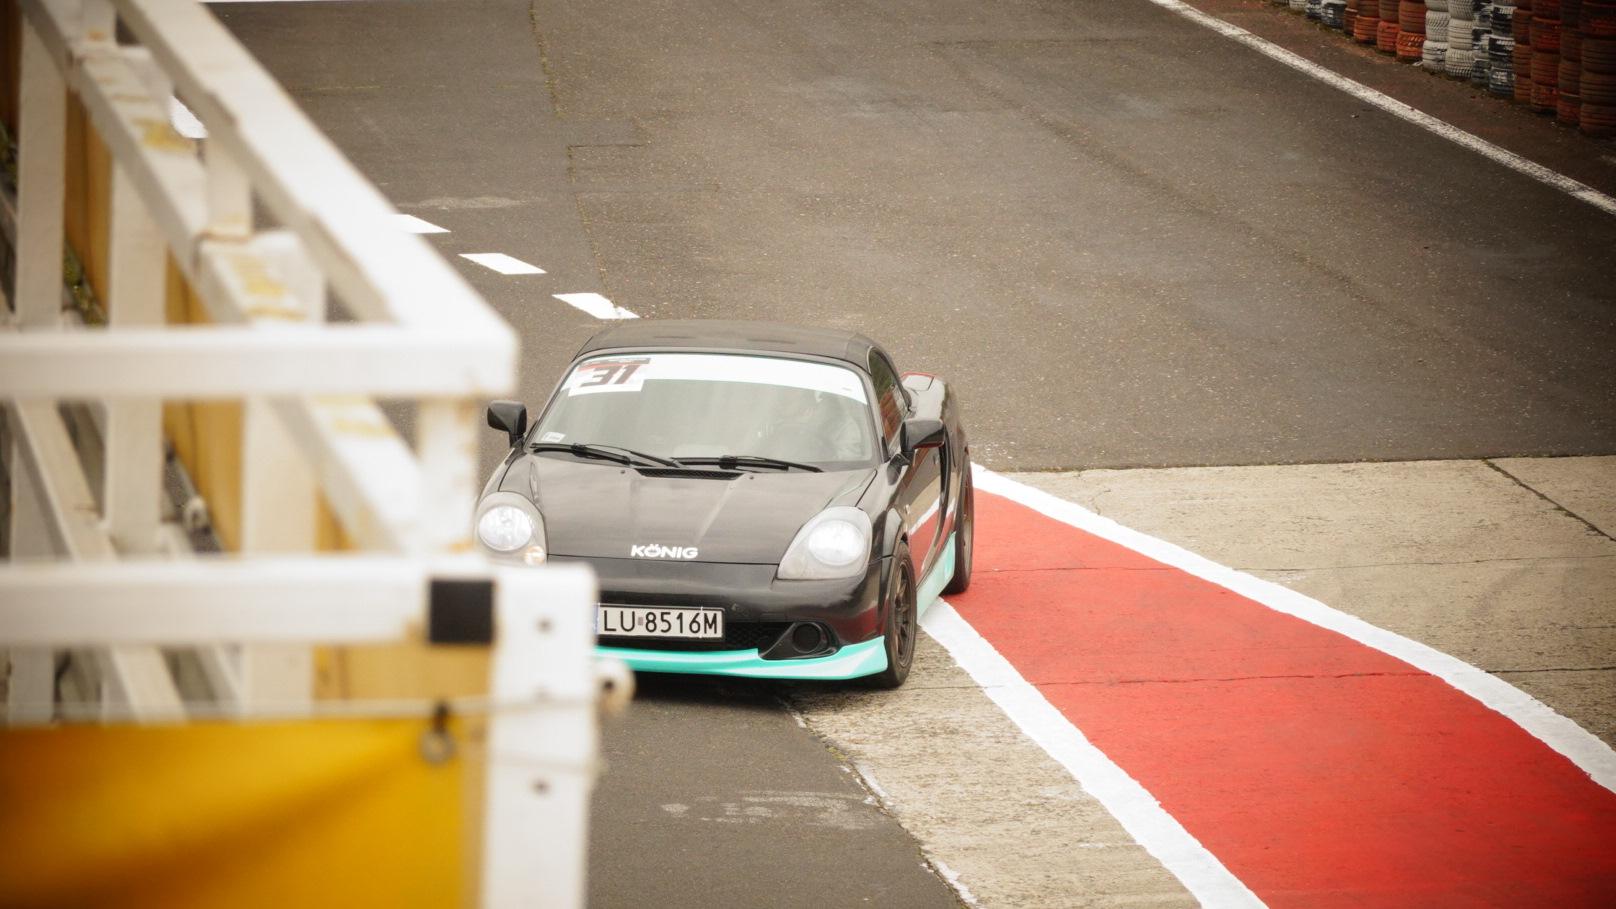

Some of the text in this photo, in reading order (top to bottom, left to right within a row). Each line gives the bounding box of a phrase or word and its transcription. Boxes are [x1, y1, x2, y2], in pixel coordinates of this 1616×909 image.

[579, 365, 640, 388] 31
[631, 544, 698, 559] KÖNIG
[604, 610, 717, 634] LU 8516M
